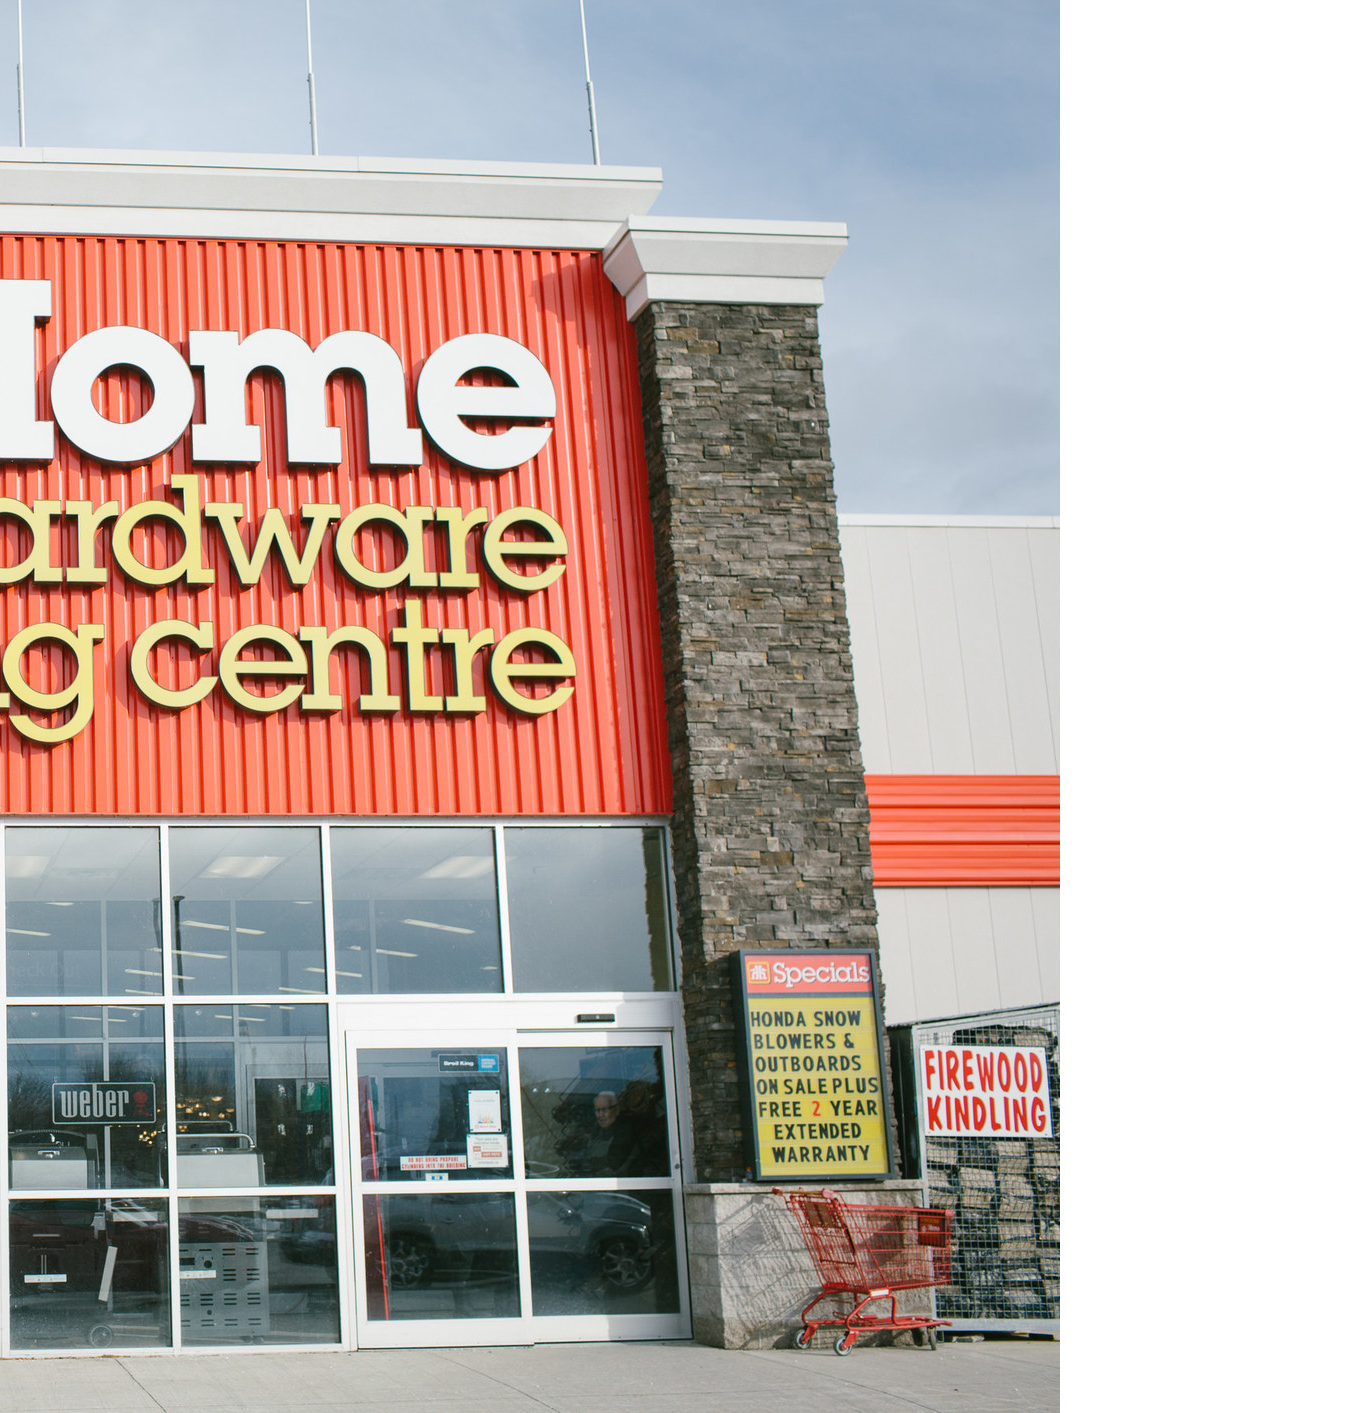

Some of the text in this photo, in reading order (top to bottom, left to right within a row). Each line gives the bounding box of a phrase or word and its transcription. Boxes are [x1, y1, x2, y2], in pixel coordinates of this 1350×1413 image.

[130, 599, 577, 715] centre
[773, 962, 870, 988] Specials
[751, 1010, 861, 1027] HONDA SNOW
[754, 1033, 854, 1049] BLOWERS &
[755, 1055, 862, 1072] OUTBOARDS
[925, 1050, 1042, 1093] FIREWOOD
[757, 1077, 879, 1095] ON SALE PLUS
[60, 1084, 129, 1118] weber
[759, 1100, 878, 1117] FREE 2 YEAR
[927, 1094, 1046, 1133] KINDLING
[774, 1123, 861, 1140] EXTENDED
[772, 1145, 870, 1163] WARRANTY
